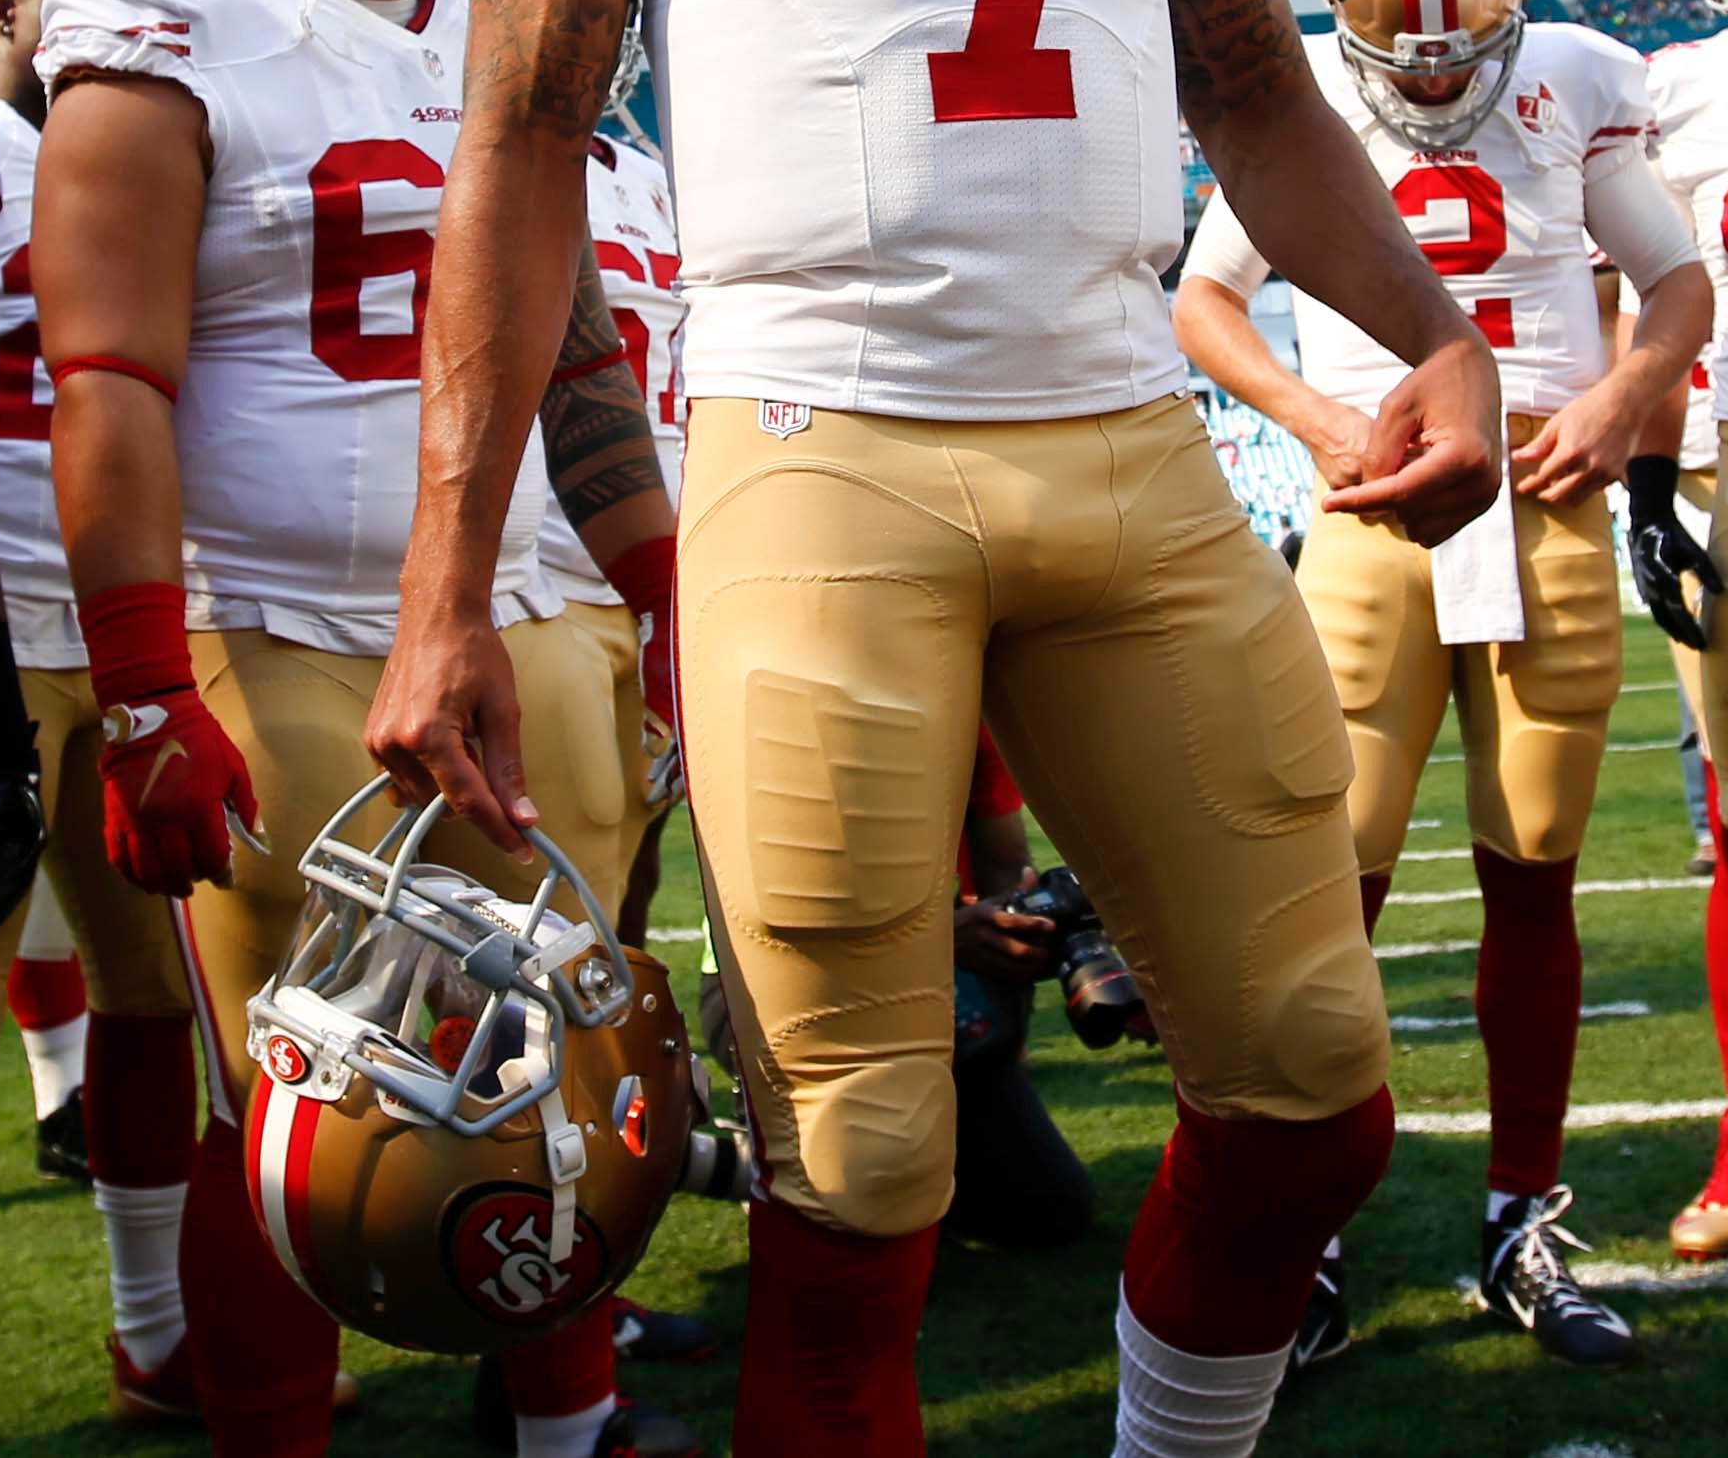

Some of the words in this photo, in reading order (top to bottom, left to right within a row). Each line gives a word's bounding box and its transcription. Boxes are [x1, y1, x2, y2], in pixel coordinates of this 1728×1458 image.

[409, 105, 464, 124] 49ER
[766, 401, 802, 428] NFL
[476, 1214, 585, 1315] SF
